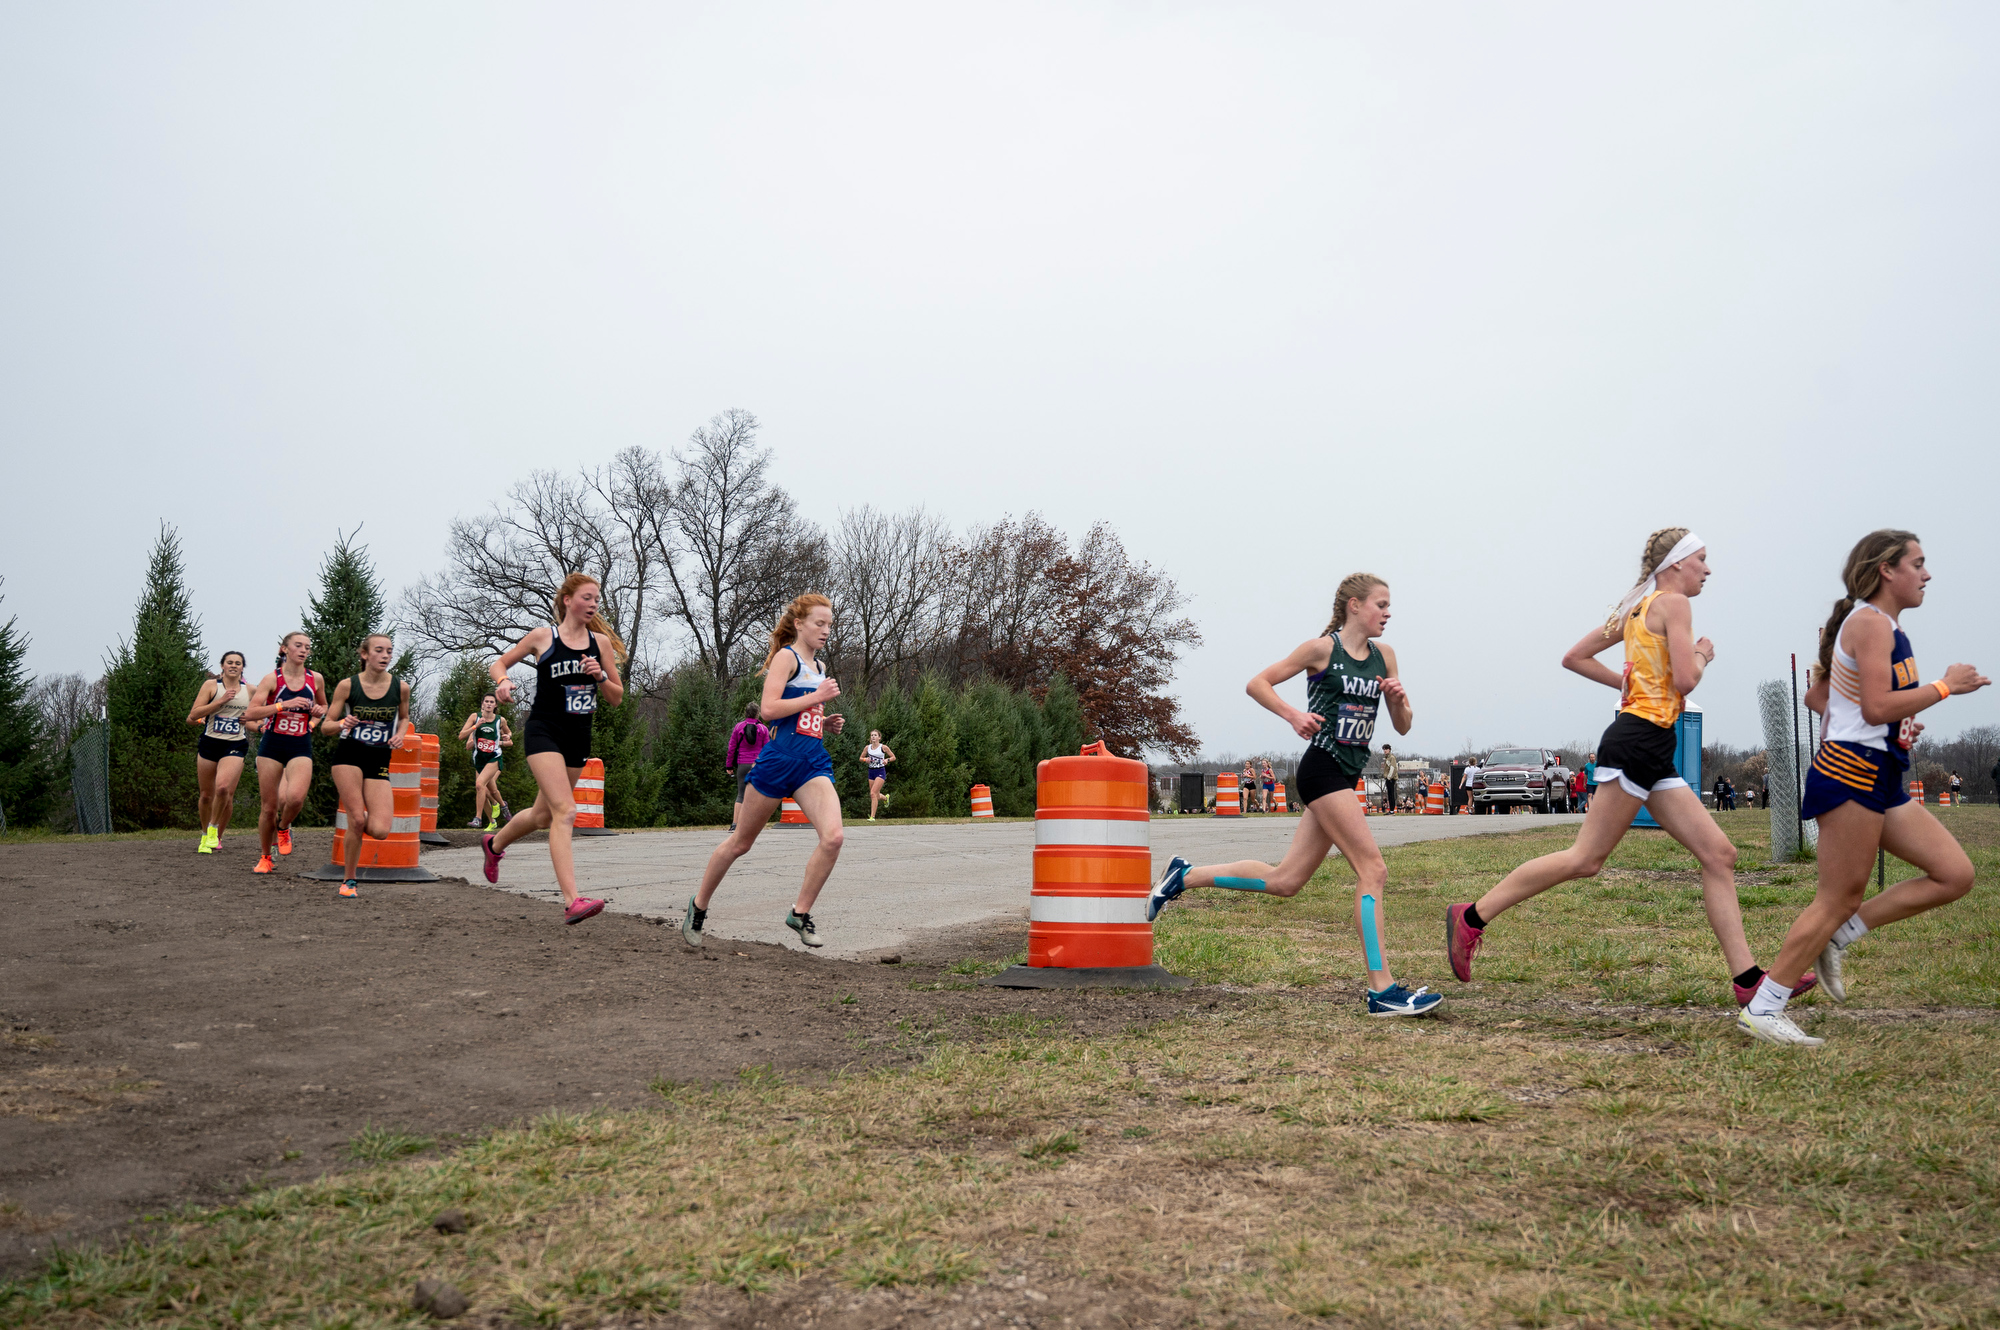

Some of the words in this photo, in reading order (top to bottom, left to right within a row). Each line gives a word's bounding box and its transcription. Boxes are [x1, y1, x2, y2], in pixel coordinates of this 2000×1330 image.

[550, 660, 571, 678] ELK
[1341, 675, 1379, 698] WMC
[566, 694, 597, 711] 1624
[353, 705, 396, 720] SMCC
[214, 720, 240, 732] 1763
[278, 718, 305, 733] 851
[1337, 717, 1374, 740] 1700
[354, 726, 389, 742] 1691
[478, 741, 494, 751] 894
